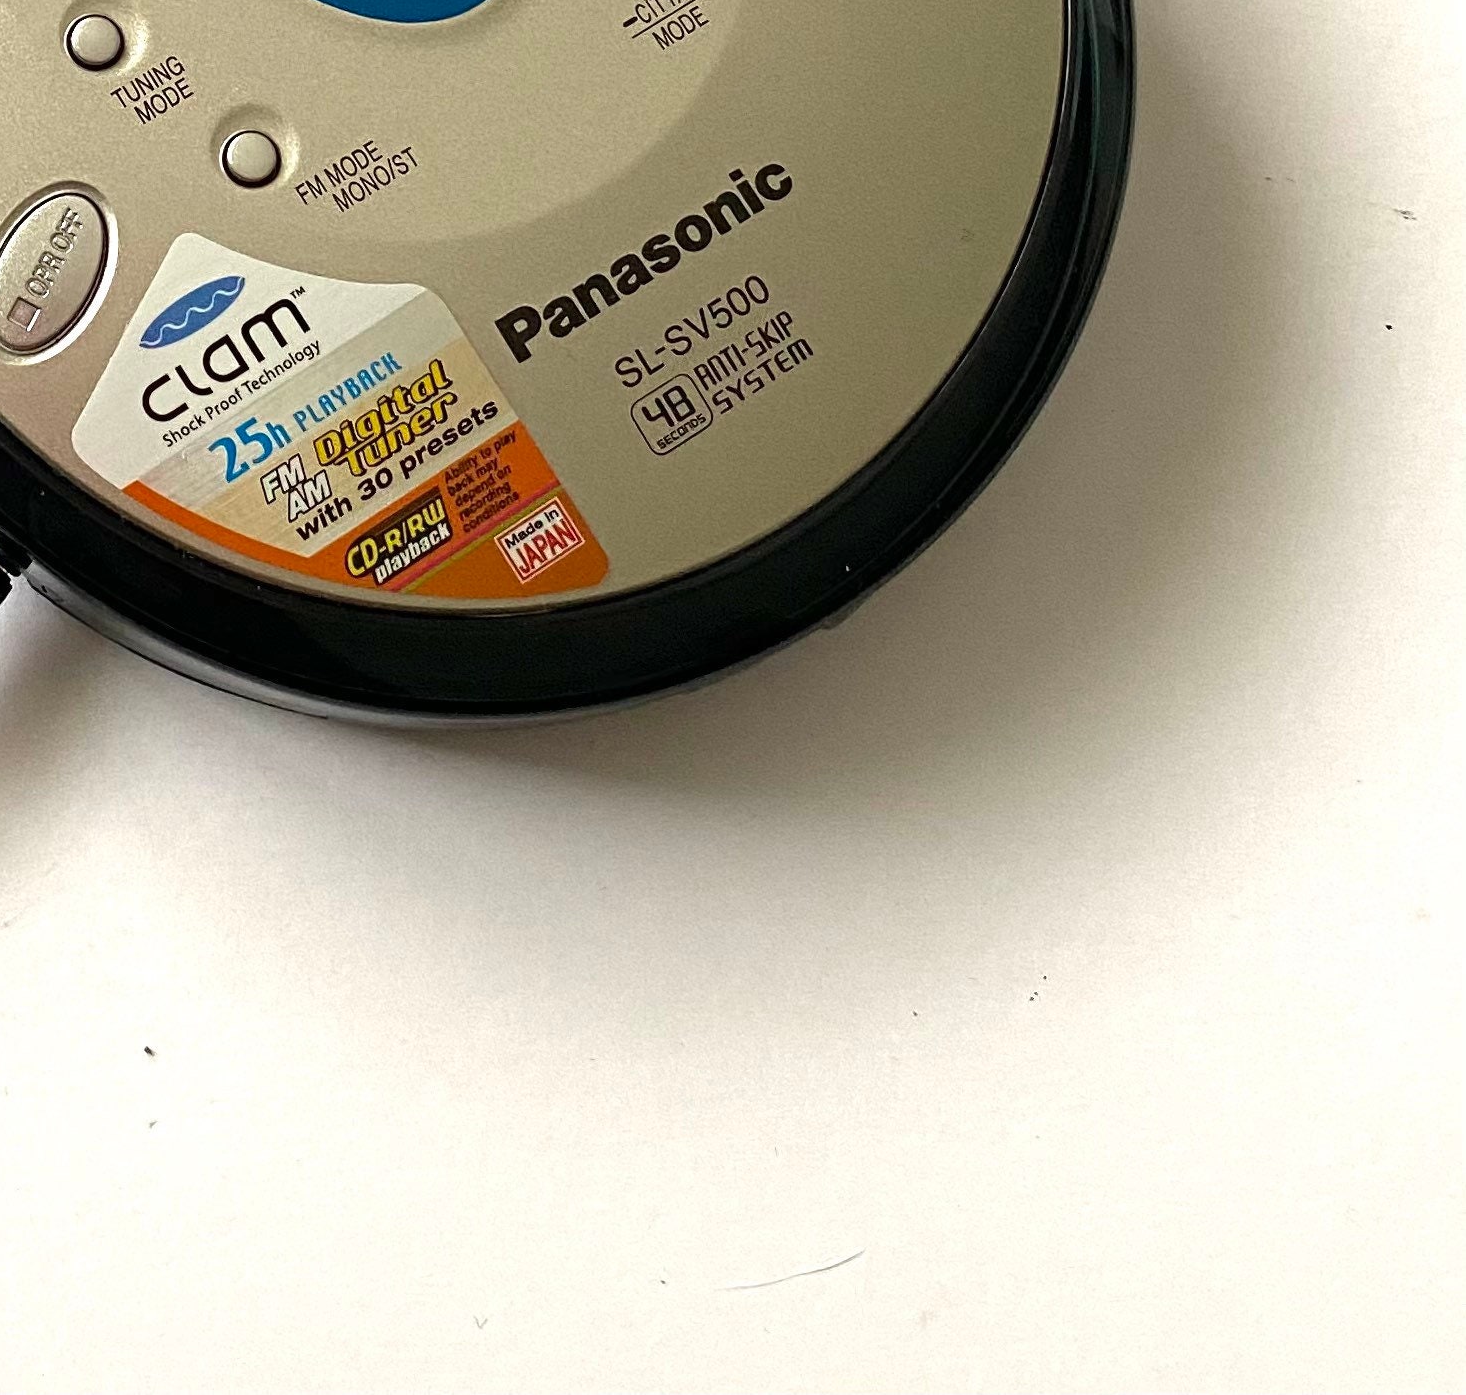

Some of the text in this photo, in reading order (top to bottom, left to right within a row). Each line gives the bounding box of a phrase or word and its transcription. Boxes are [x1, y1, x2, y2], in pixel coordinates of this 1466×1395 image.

[652, 6, 710, 50] MODE
[110, 56, 185, 108] TUNING
[134, 77, 195, 125] MODE
[295, 140, 384, 205] FM MODE
[332, 146, 418, 213] MONO/ST
[25, 207, 84, 298] OPR OFF
[494, 163, 793, 364] Panasonic
[614, 275, 770, 388] SL-SV500
[693, 310, 794, 392] ANTI-SKIP
[162, 340, 322, 447] Shock Proof Technology
[711, 338, 814, 416] SYSTEM
[207, 352, 403, 483] 25h PLAYBACK
[313, 358, 453, 466] Digital
[335, 391, 458, 477] Tuner
[656, 413, 707, 450] SECONDS
[260, 453, 309, 505] FM
[296, 400, 499, 540] with 30 presets
[445, 430, 516, 484] Ability to play
[455, 465, 512, 507] depend on
[476, 458, 498, 479] may
[288, 469, 332, 523] AM
[460, 481, 511, 522] recording
[347, 498, 446, 577] CD-R/RW
[374, 522, 451, 584] playback
[504, 519, 544, 550] Made
[516, 519, 576, 574] JAPAN
